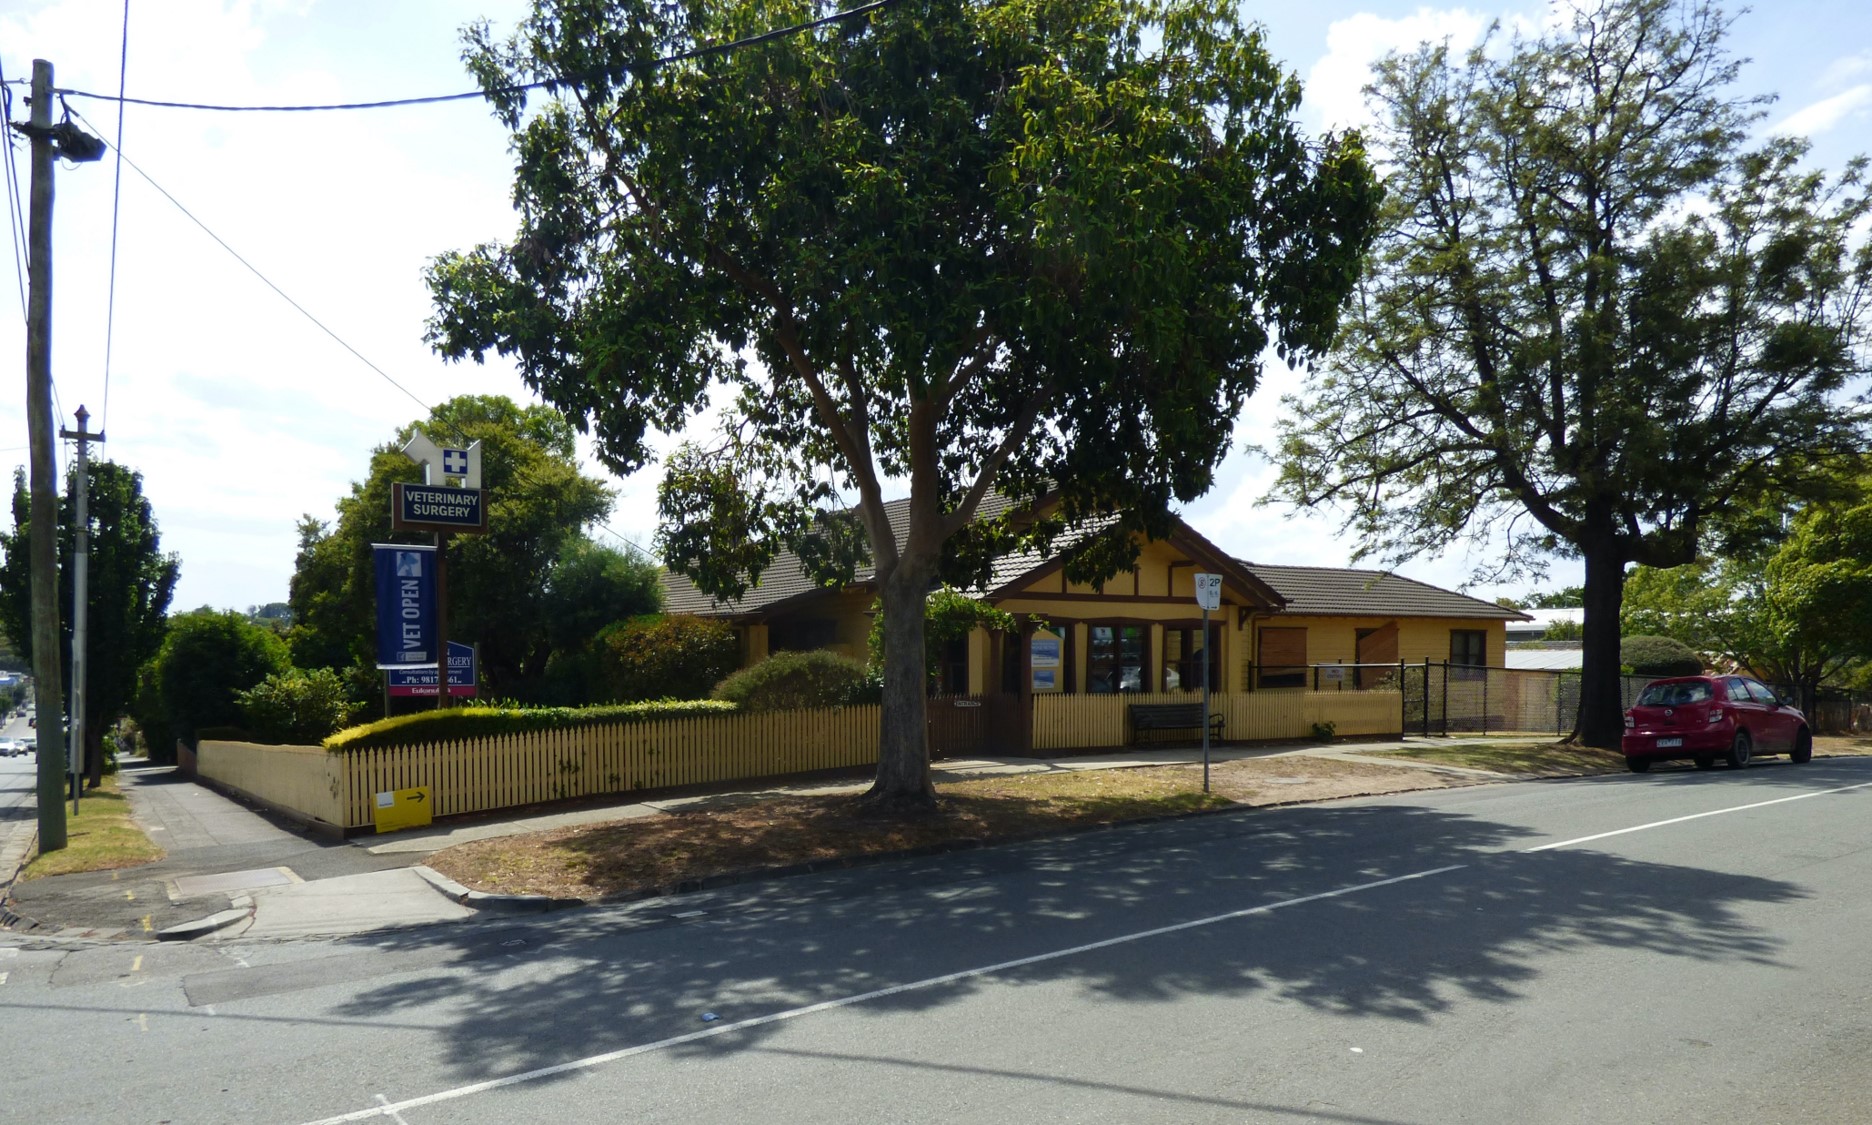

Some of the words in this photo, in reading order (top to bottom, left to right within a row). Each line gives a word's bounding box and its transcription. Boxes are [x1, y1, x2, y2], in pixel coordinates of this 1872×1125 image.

[406, 491, 478, 506] VETERINARY
[413, 504, 471, 517] SURGERY
[1209, 578, 1220, 587] 2P
[401, 579, 420, 619] OPEN
[402, 622, 421, 649] VET
[446, 656, 471, 666] RGERY
[406, 676, 419, 684] Ph:
